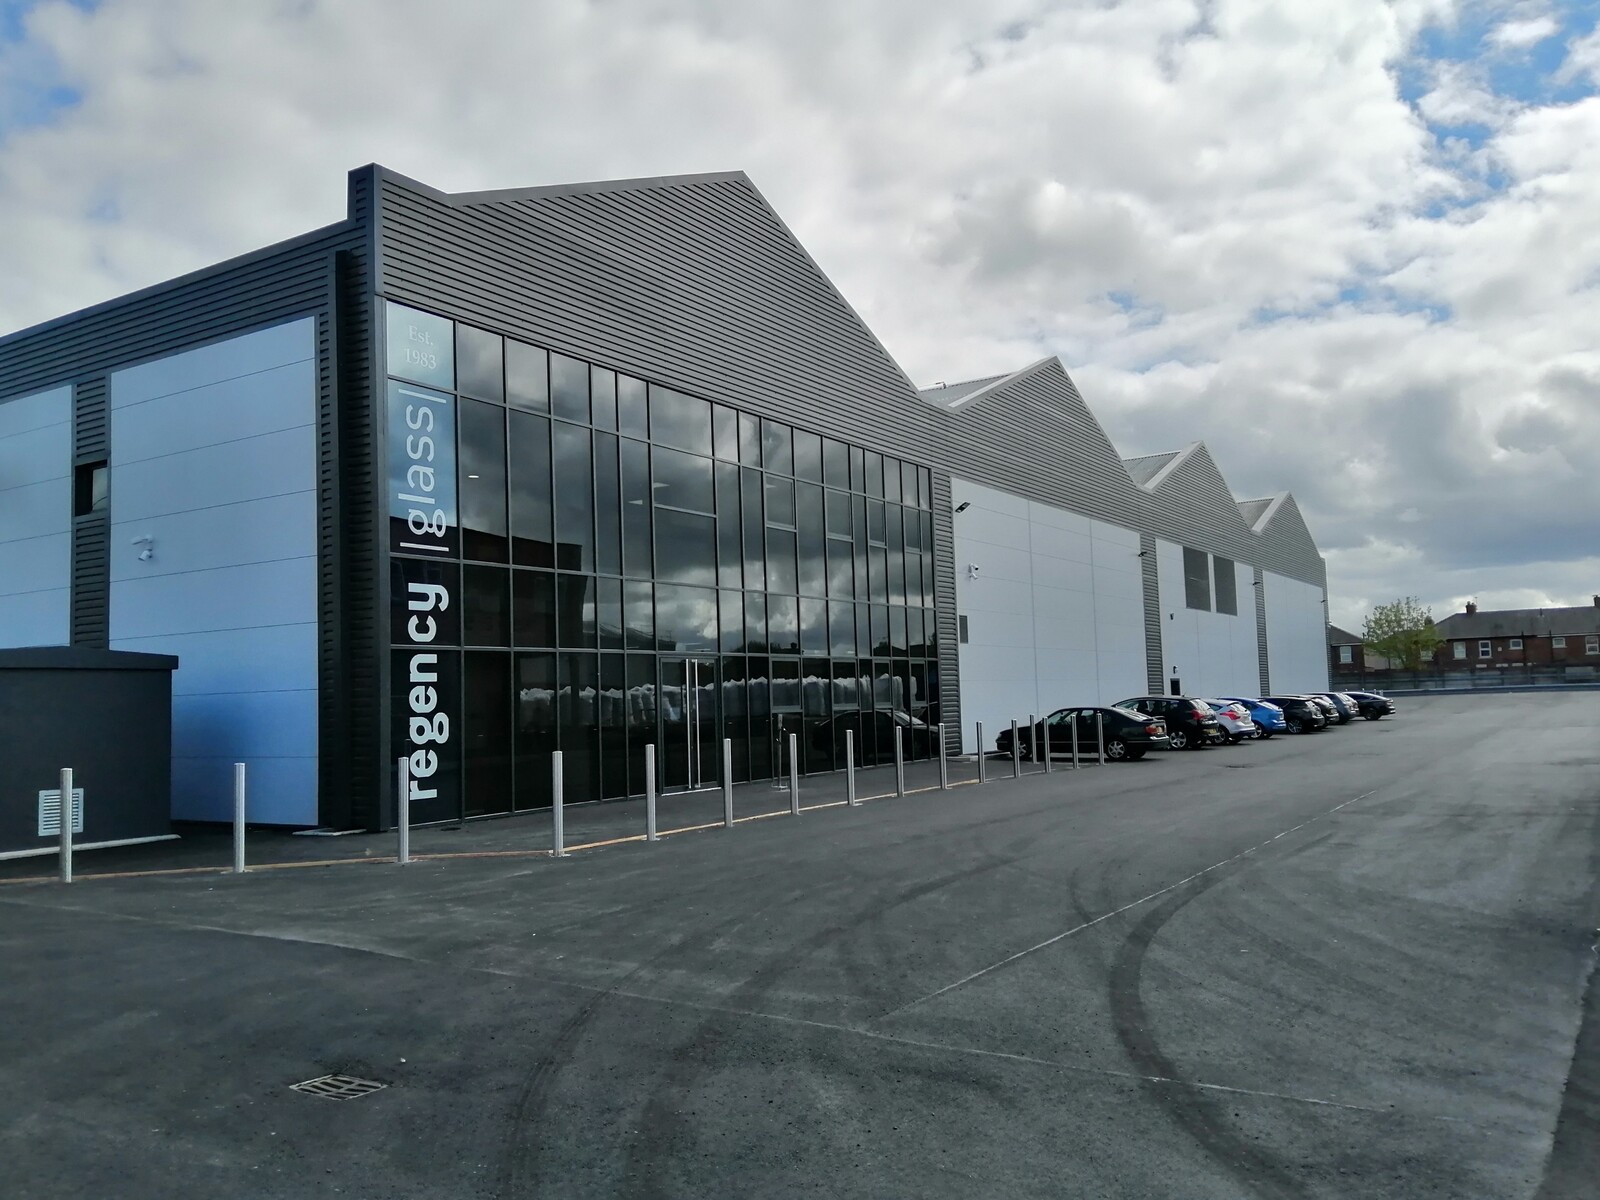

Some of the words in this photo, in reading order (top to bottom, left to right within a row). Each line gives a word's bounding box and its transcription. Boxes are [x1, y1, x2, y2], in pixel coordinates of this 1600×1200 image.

[408, 325, 433, 346] Est.
[404, 346, 437, 370] 1983
[408, 583, 449, 801] regency
